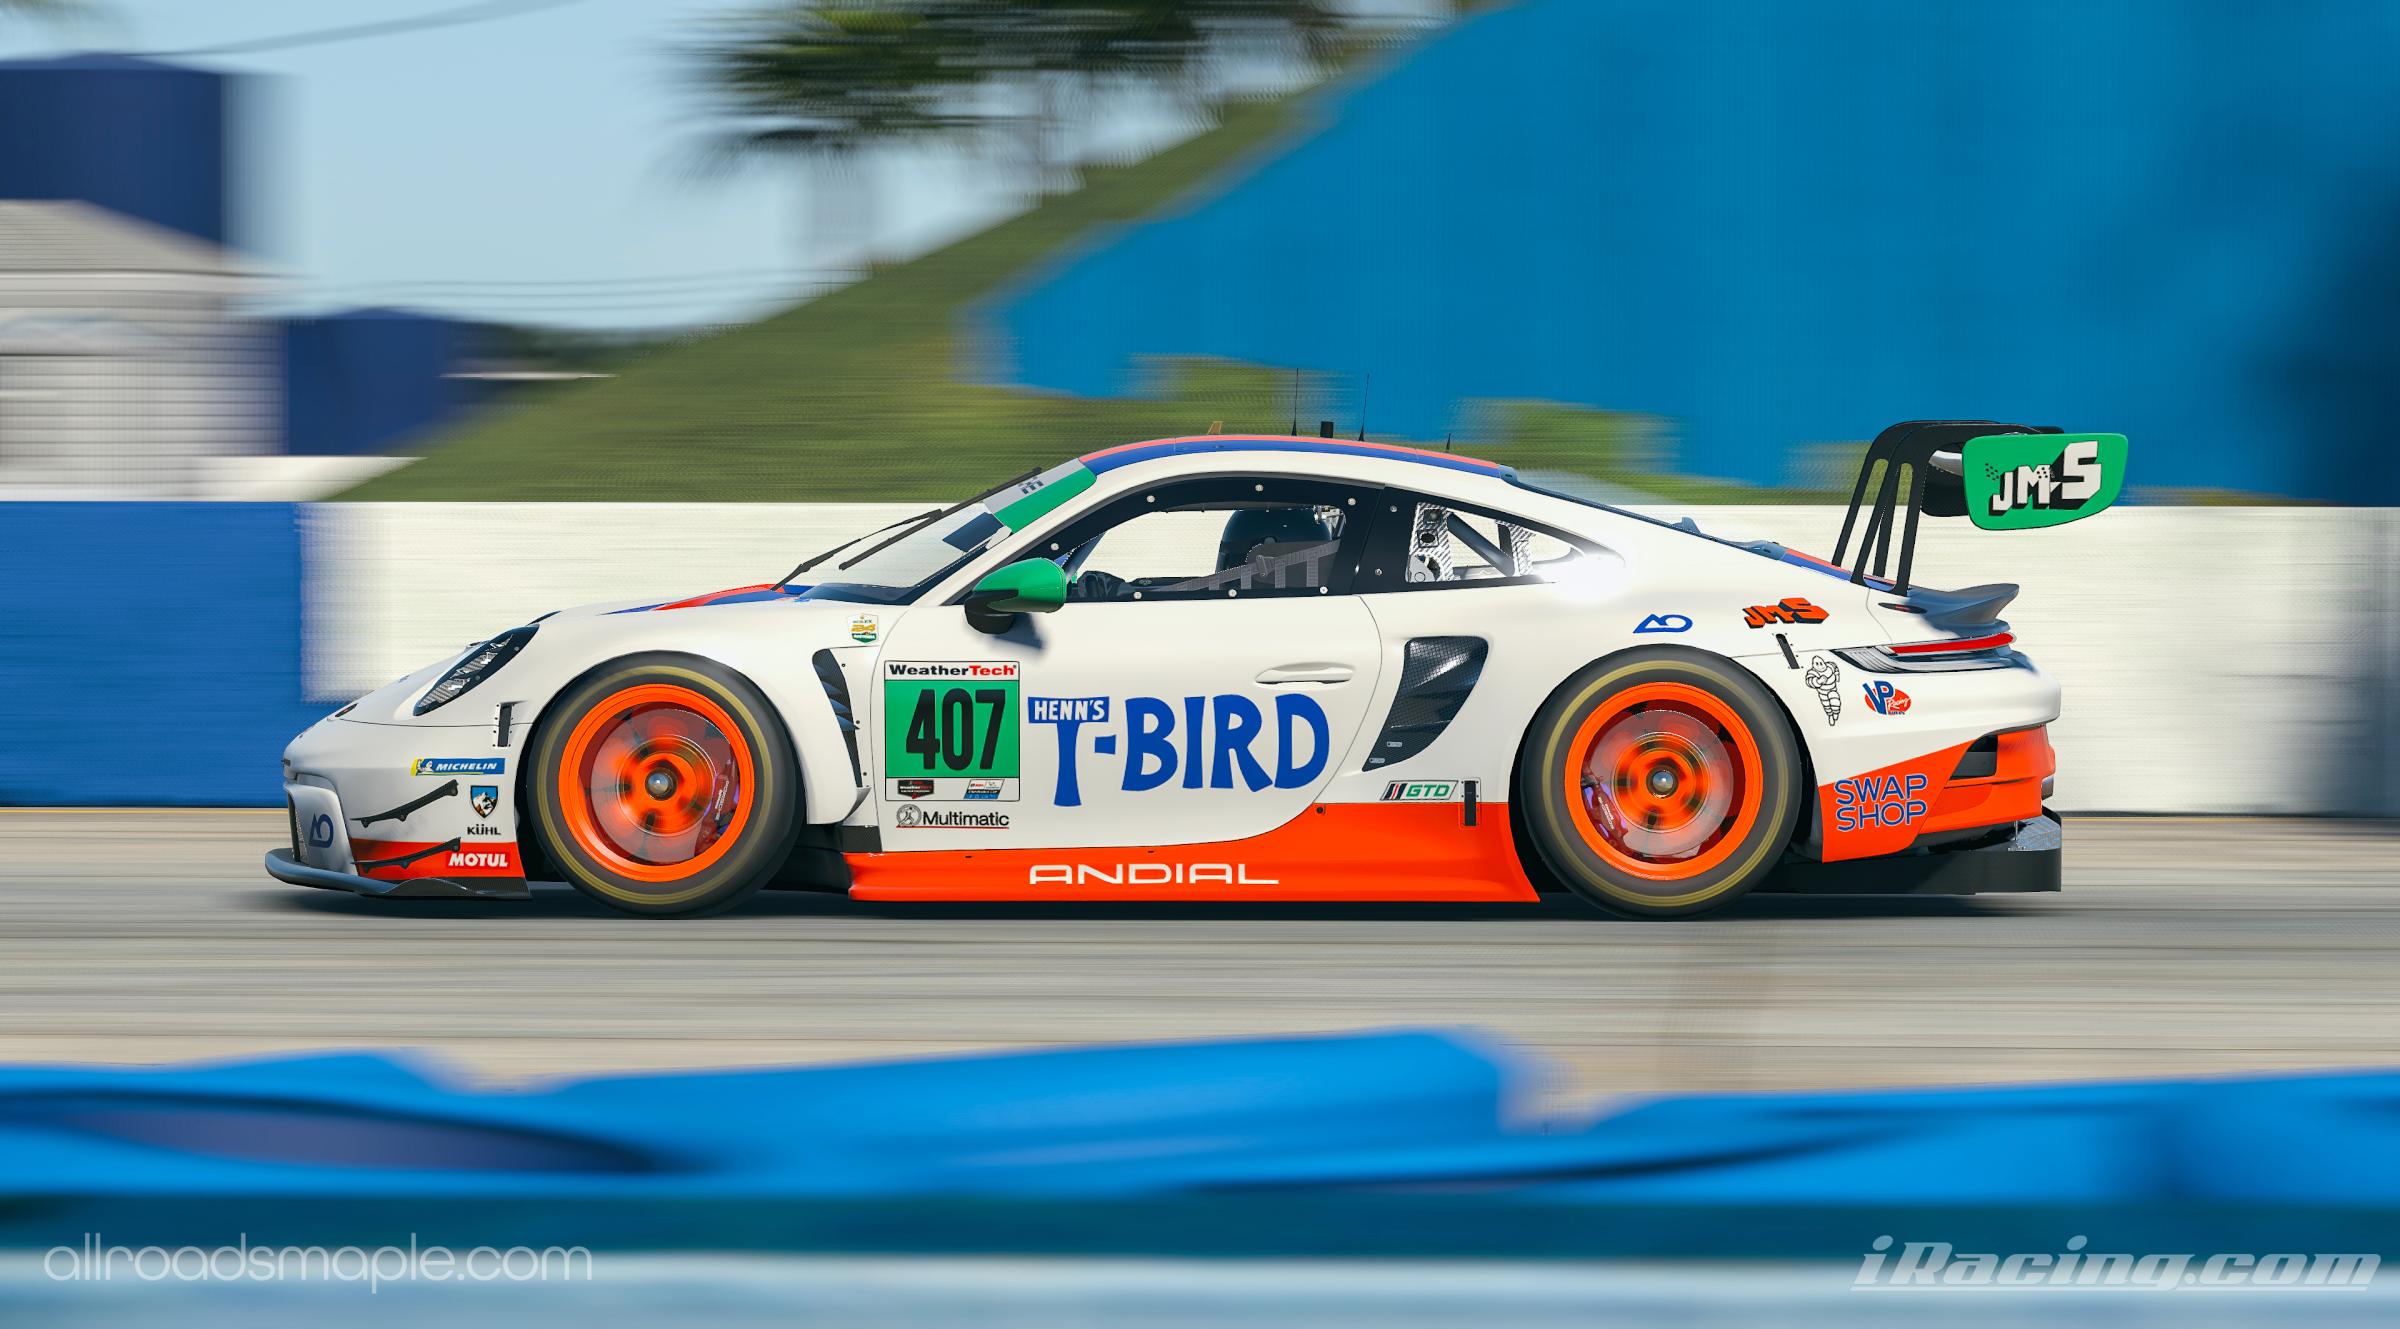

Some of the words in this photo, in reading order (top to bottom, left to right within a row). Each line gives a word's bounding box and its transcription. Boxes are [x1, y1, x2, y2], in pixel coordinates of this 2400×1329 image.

[1862, 680, 1895, 715] VP
[1034, 699, 1106, 722] HENN'S
[905, 687, 1006, 771] 407
[1027, 693, 1330, 807] T-BIRD
[435, 762, 498, 771] MICHELIN
[1405, 784, 1450, 798] GTD
[1834, 773, 1929, 806] SWAP
[922, 811, 1010, 827] Multimatic
[1835, 800, 1928, 832] SHOP
[466, 823, 502, 836] KÜHL
[447, 852, 509, 867] MOTUL
[1029, 863, 1280, 885] ANDIAL
